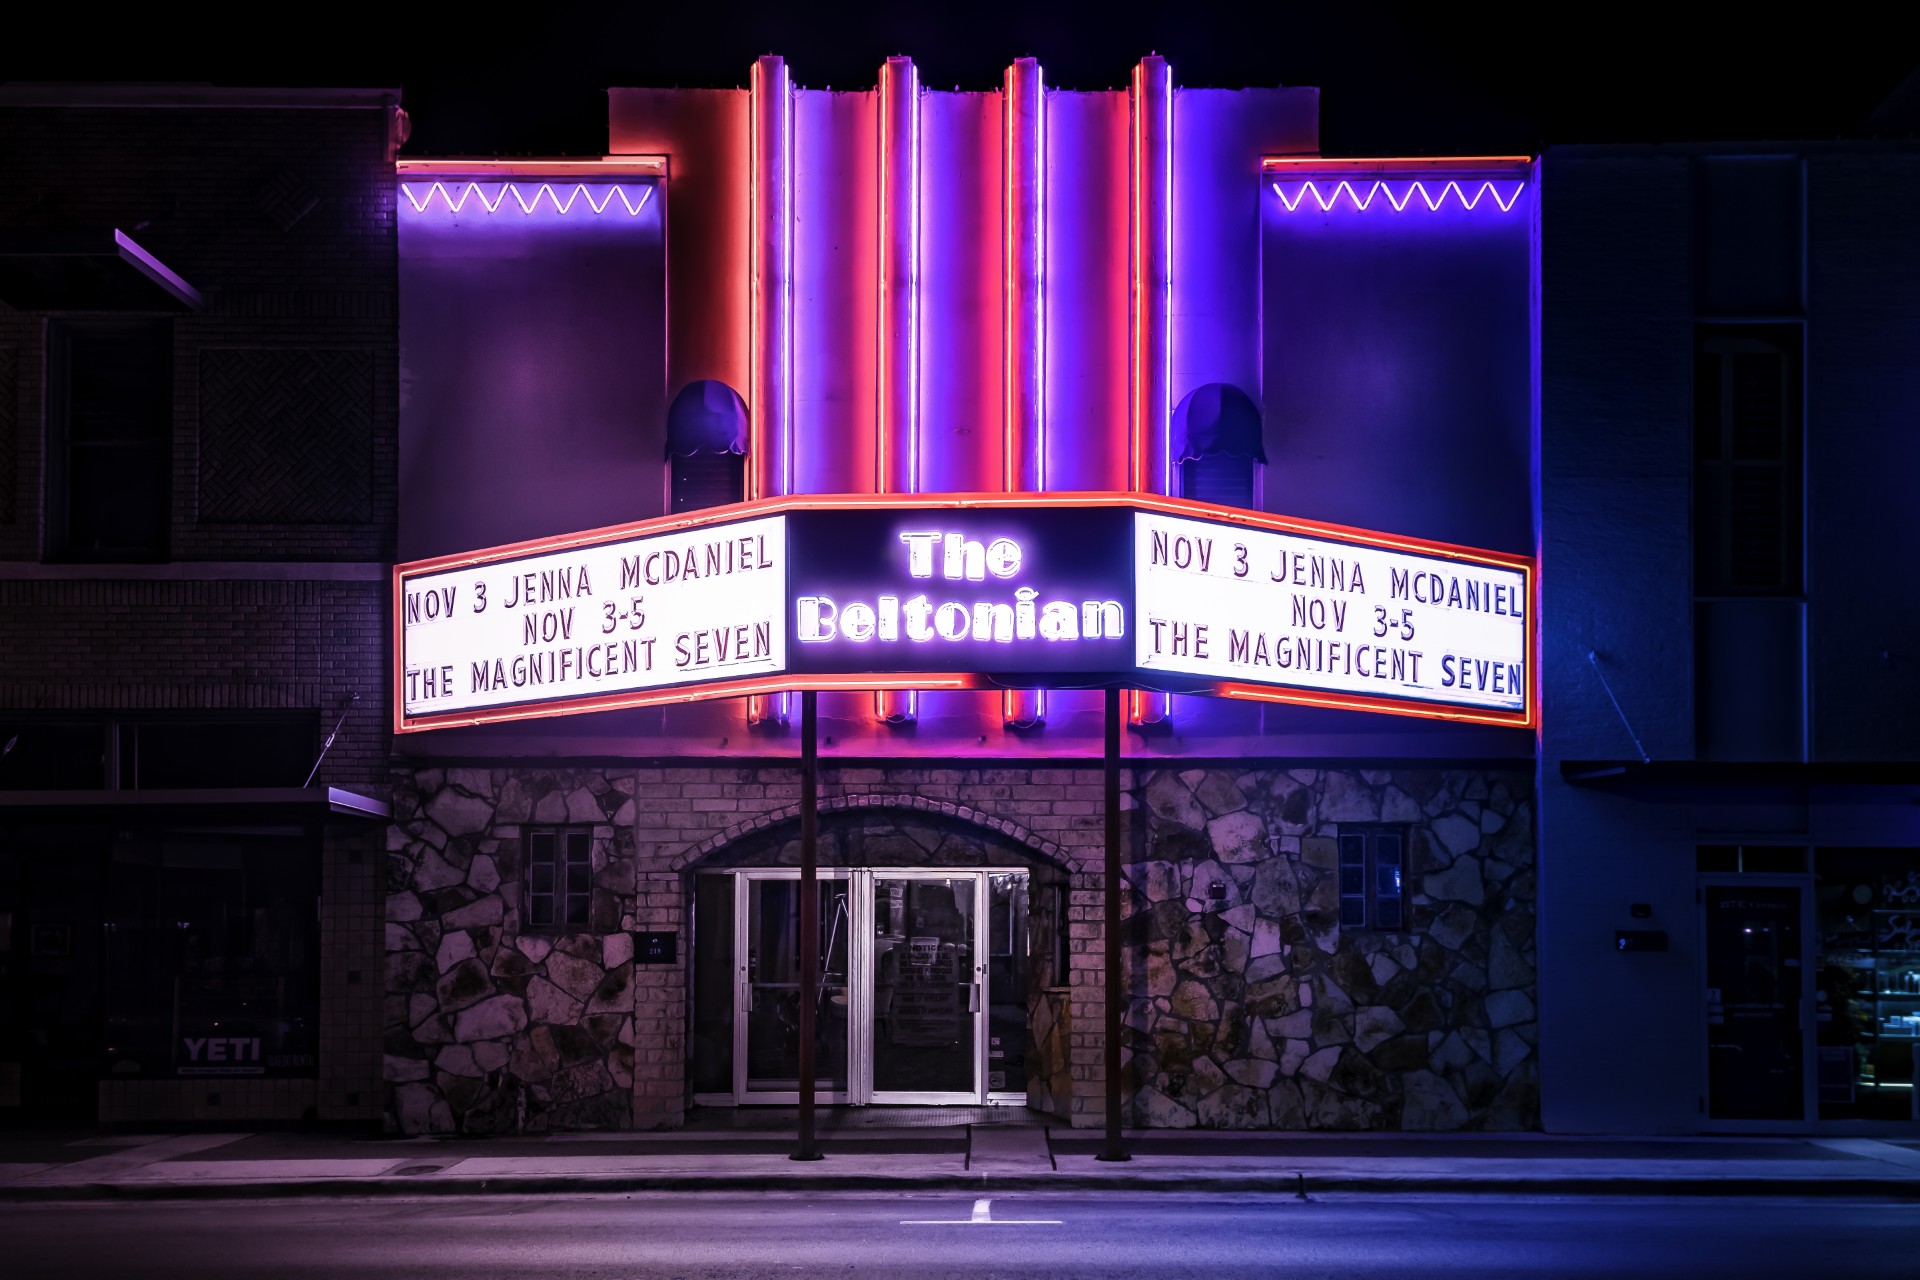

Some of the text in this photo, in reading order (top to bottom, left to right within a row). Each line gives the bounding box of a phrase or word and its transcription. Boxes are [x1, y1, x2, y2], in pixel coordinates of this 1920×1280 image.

[407, 534, 773, 624] NOV 3 JENNA MCDANIEL
[899, 531, 1022, 581] The
[1150, 529, 1522, 618] NOV 3 JENNA MCDANIEL
[523, 596, 645, 645] NOV 3-5
[797, 586, 1125, 643] Beltonian
[1291, 593, 1415, 641] NOV 3-5
[407, 621, 771, 701] THE MAGNIFICENT SEVEN
[1149, 618, 1522, 696] THE MAGNIFICENT SEVEN
[183, 1037, 261, 1061] YETI
